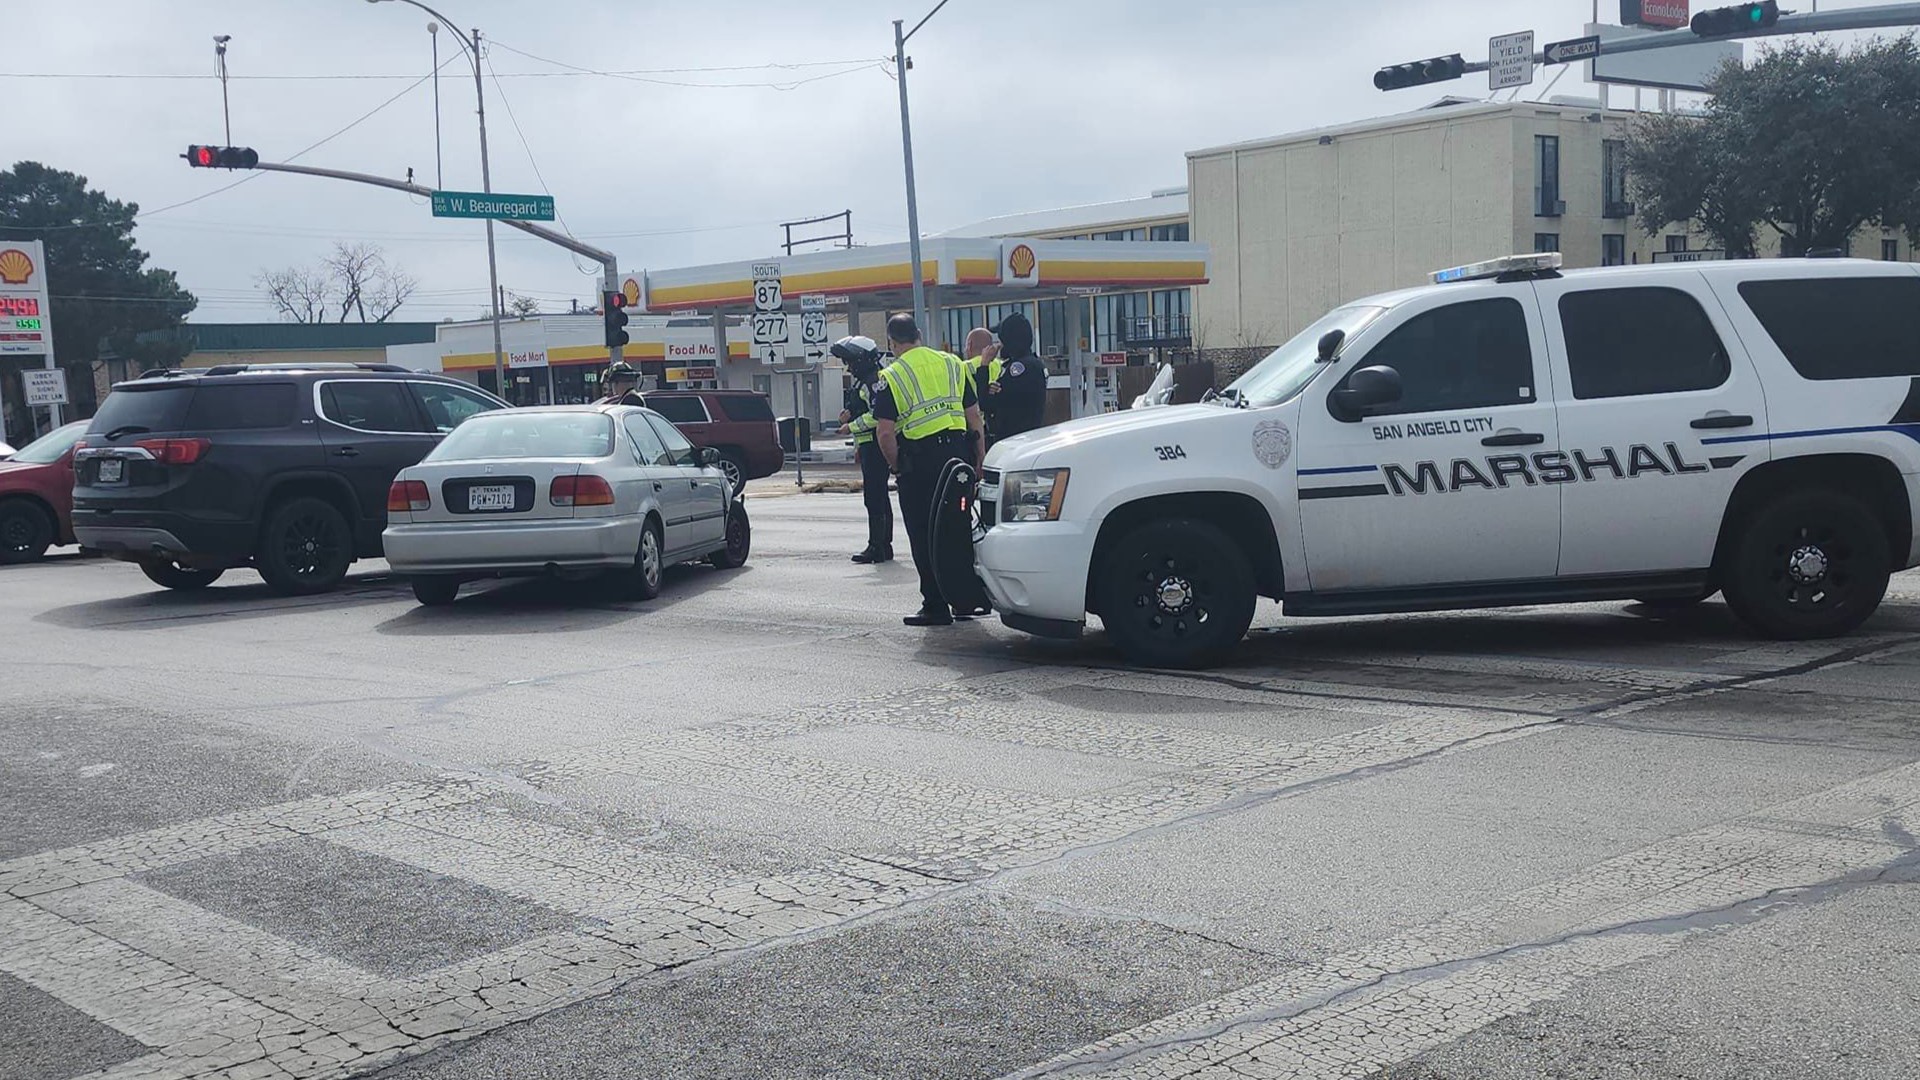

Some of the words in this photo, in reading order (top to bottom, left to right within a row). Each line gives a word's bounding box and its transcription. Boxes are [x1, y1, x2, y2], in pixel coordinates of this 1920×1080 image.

[1492, 40, 1507, 48] LEFT
[1515, 35, 1531, 43] TURN
[1500, 46, 1523, 57] YIELD
[1560, 47, 1576, 57] ONE
[1578, 43, 1594, 53] WAY
[1501, 55, 1531, 66] FLASHING
[1500, 66, 1522, 75] YELLOW
[1500, 76, 1521, 84] ARROW
[450, 198, 466, 212] W.
[469, 199, 537, 217] Beauregard
[754, 266, 779, 276] SOUTH
[758, 286, 778, 303] 87
[802, 297, 824, 305] BUSINESS
[756, 318, 784, 335] 277
[805, 319, 823, 337] 67
[669, 344, 695, 355] Food
[510, 353, 527, 363] Food
[529, 352, 545, 361] Mart
[924, 403, 939, 414] CITY
[1372, 424, 1403, 440] SAN
[1407, 420, 1461, 438] ANGELO
[1464, 417, 1493, 432] CITY
[1154, 445, 1187, 461] 384
[1382, 441, 1708, 496] MARSHAL
